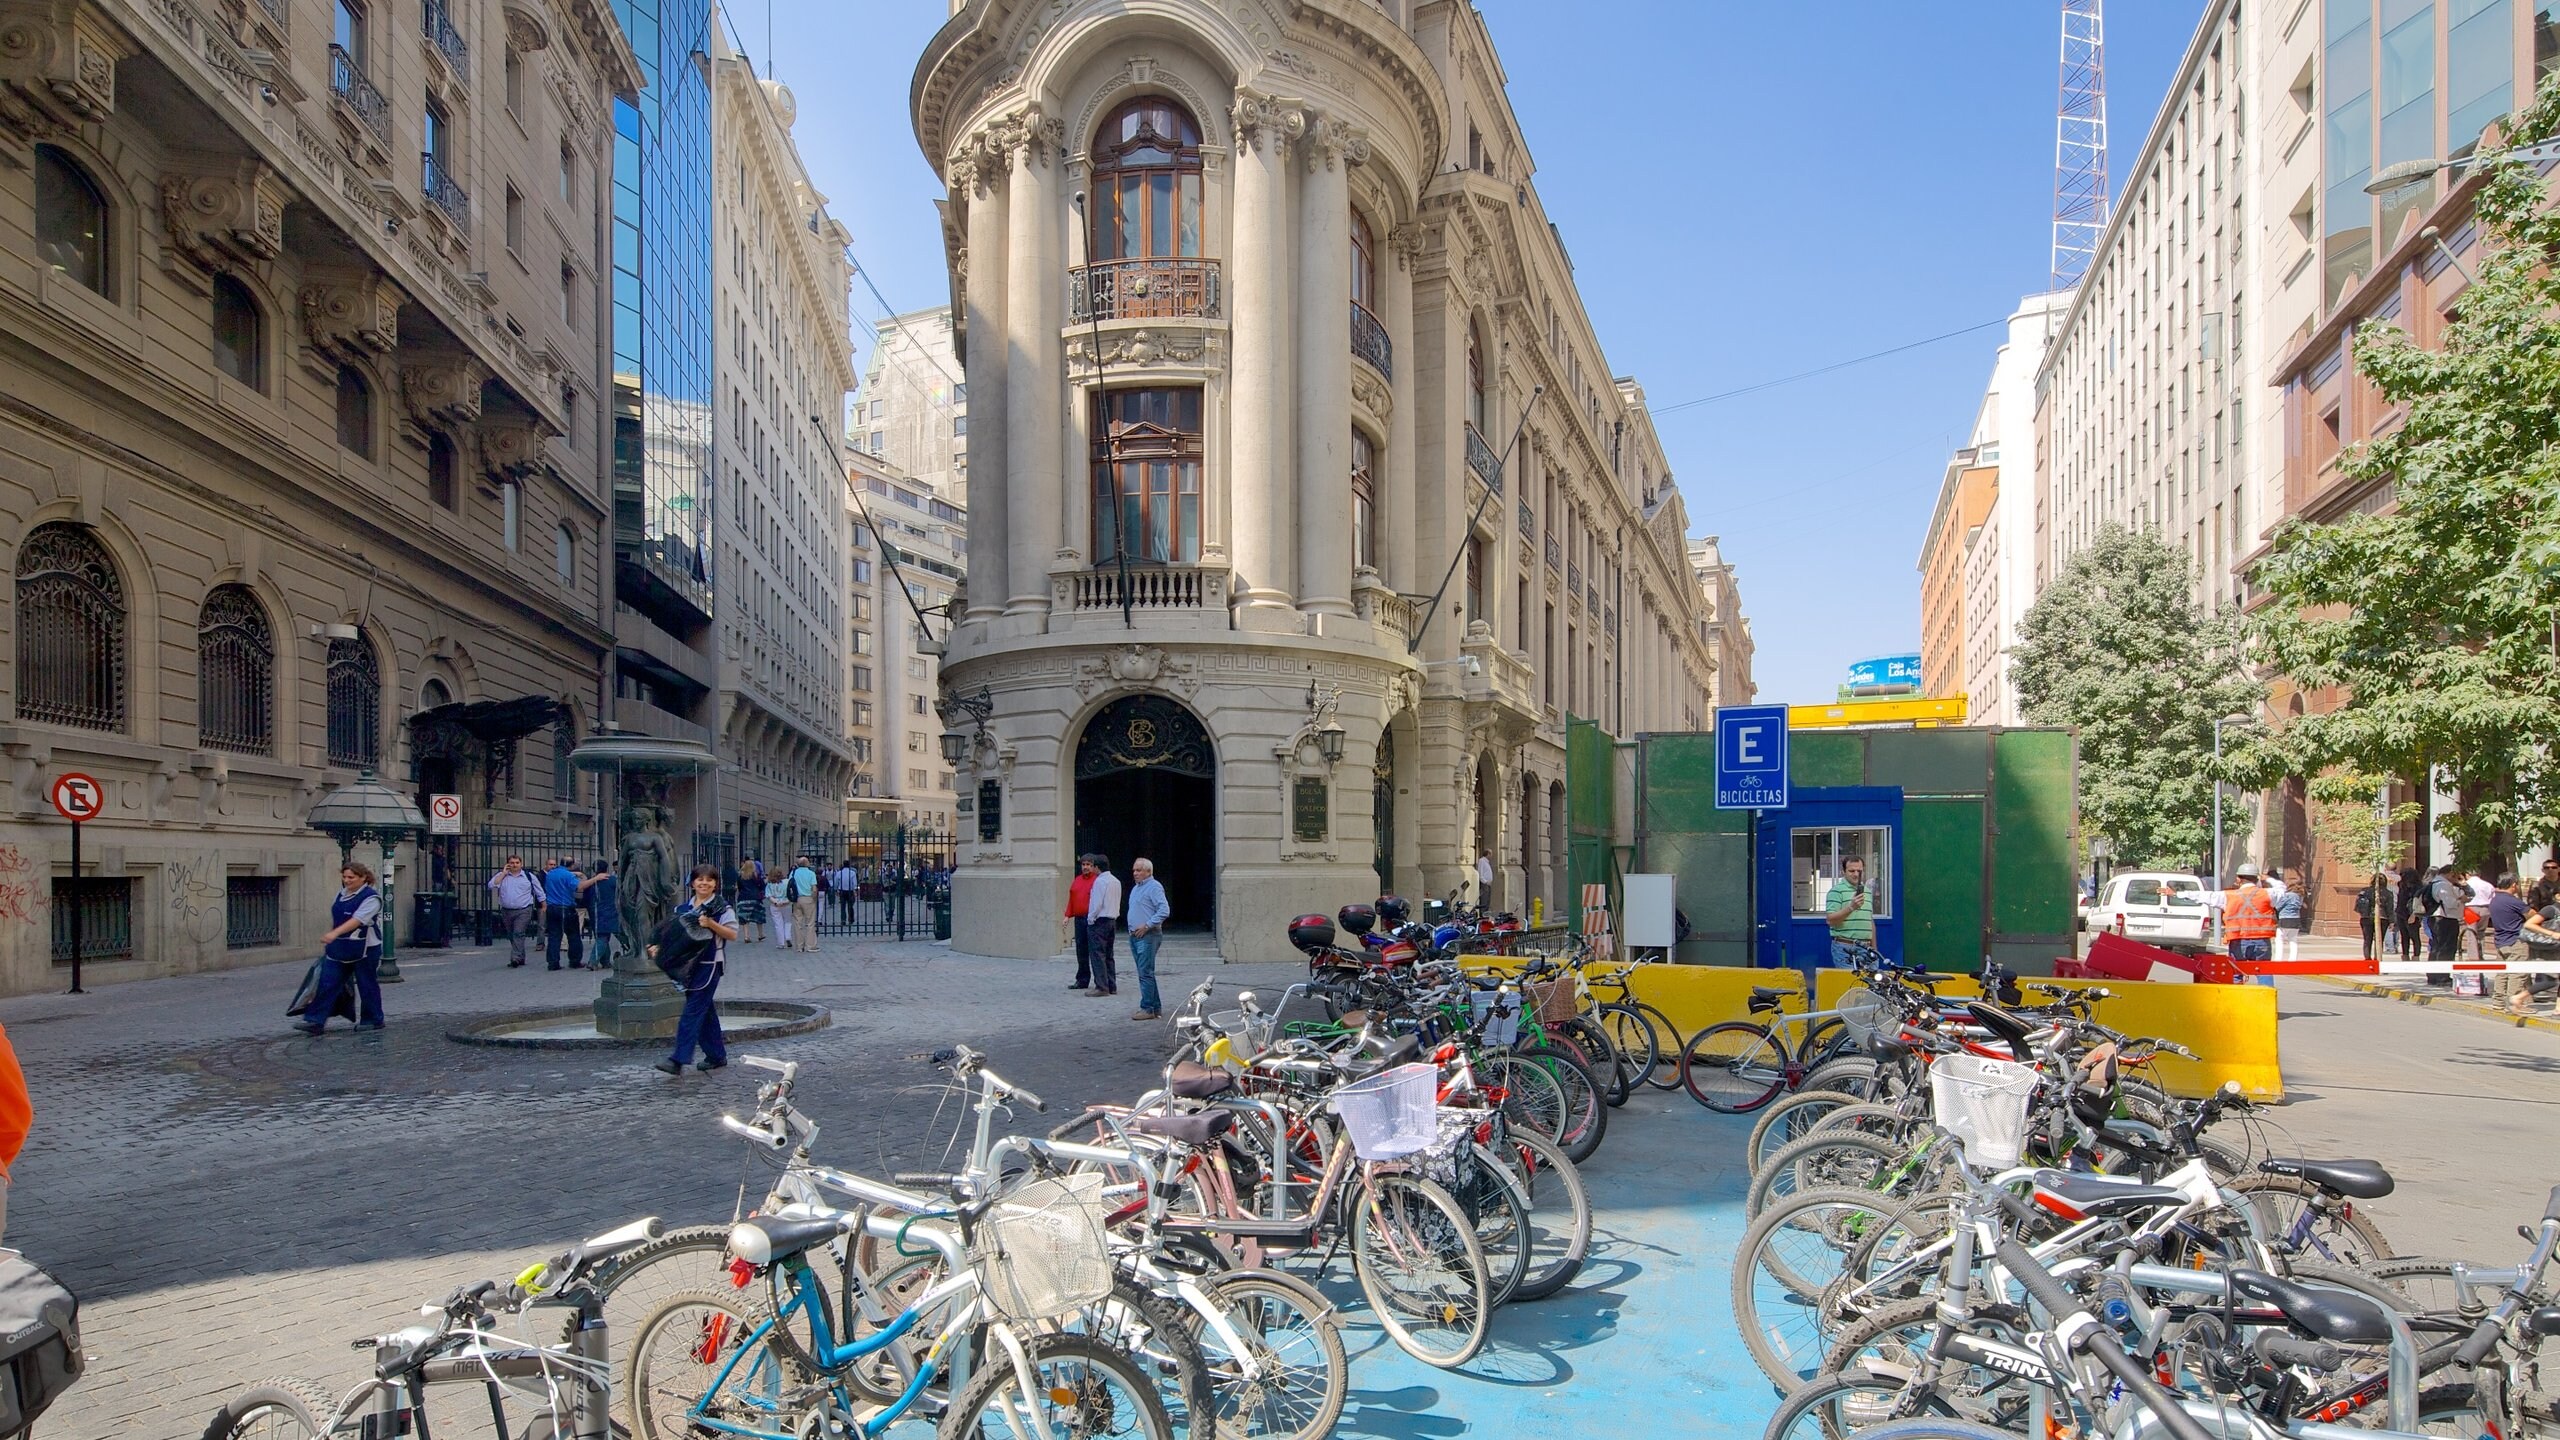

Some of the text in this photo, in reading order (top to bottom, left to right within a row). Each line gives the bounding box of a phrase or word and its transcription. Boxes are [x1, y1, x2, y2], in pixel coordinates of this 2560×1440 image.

[1888, 669, 1904, 677] Los
[1739, 726, 1763, 763] E
[69, 781, 89, 811] E
[1299, 788, 1322, 796] BOLSA
[1720, 789, 1782, 804] BICICLETAS
[6, 1320, 46, 1344] OUTBACK
